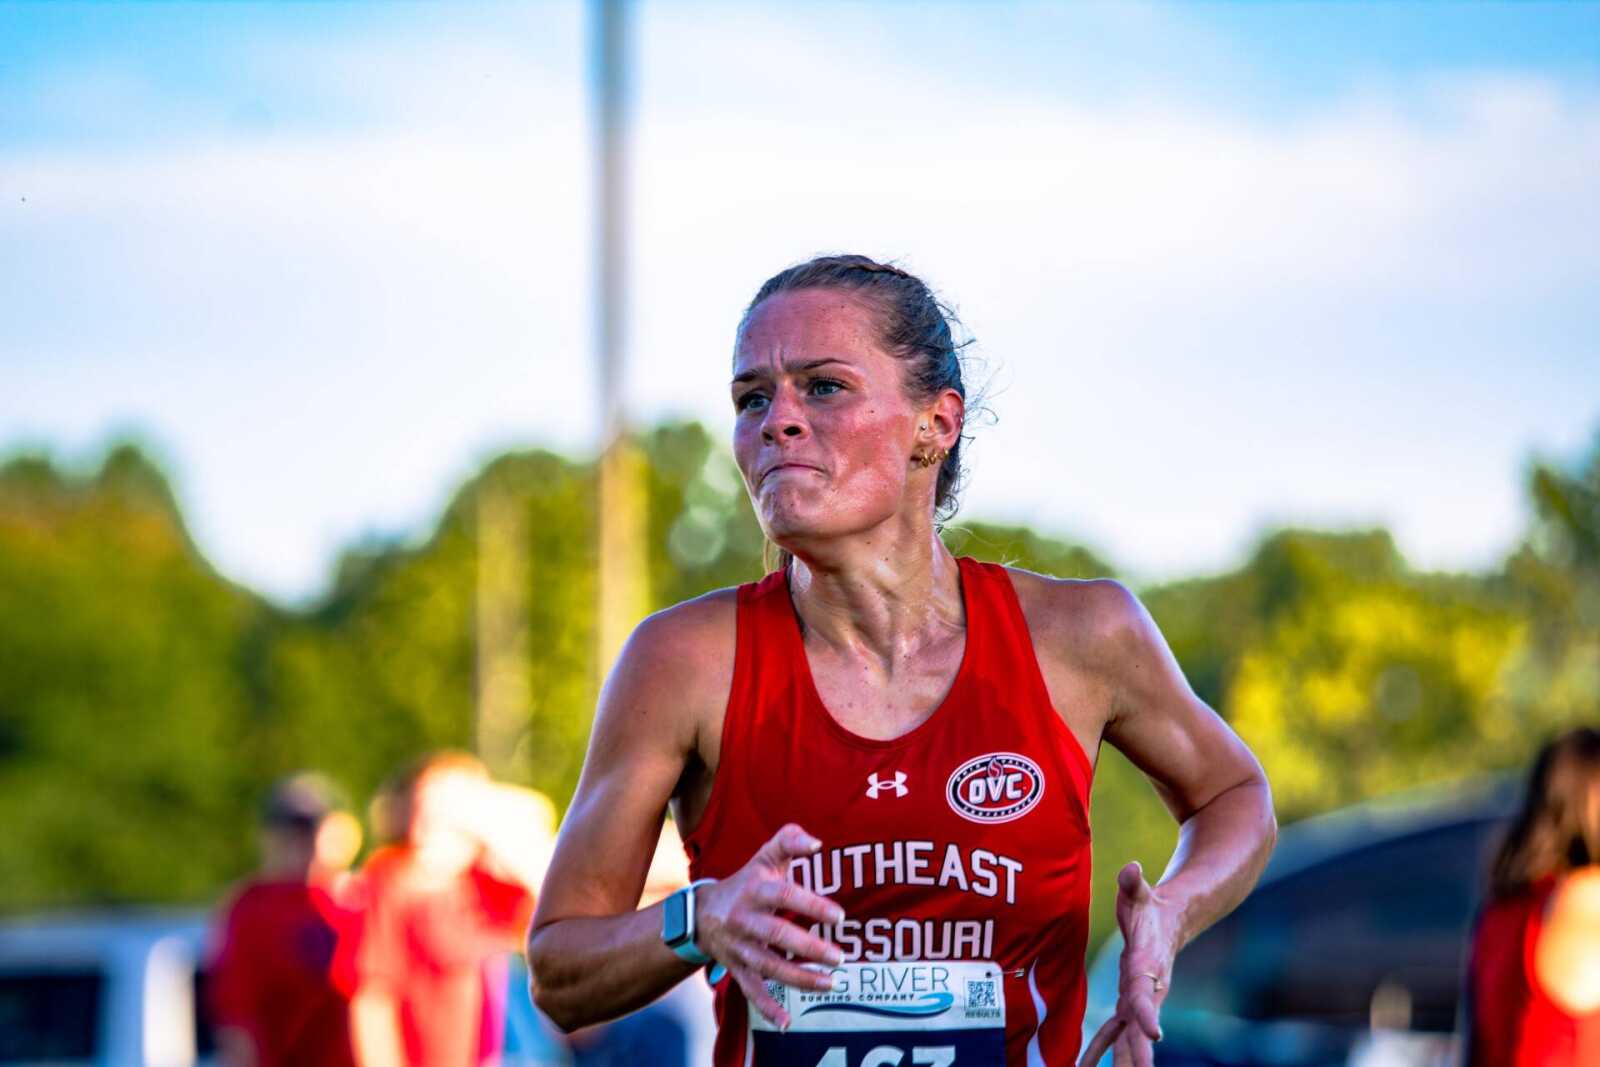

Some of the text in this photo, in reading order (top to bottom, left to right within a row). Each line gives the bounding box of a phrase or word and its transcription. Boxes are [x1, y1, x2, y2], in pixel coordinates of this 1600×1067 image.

[968, 772, 1022, 805] OVC
[787, 841, 1023, 904] OUTHEAST
[788, 918, 995, 962] ISSOURI
[859, 967, 950, 993] RIVER
[800, 992, 915, 1002] RUNNING COMPANY
